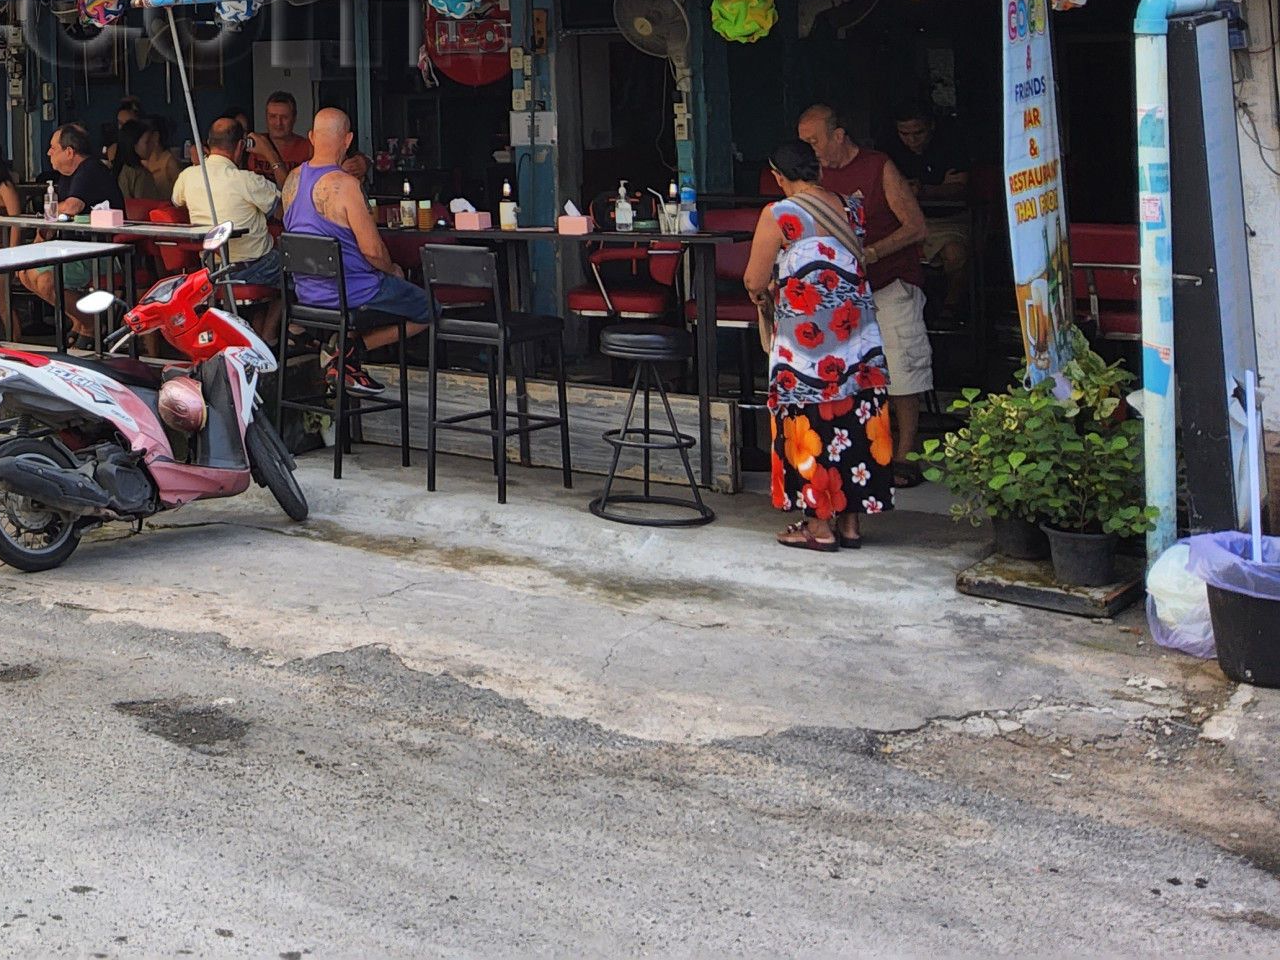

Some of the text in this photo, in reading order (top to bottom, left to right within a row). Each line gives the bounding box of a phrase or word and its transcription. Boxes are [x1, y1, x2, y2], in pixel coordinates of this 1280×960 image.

[436, 19, 508, 53] LEO
[1015, 76, 1046, 101] FRIENDS
[1029, 138, 1038, 158] &
[1015, 198, 1037, 224] THAI
